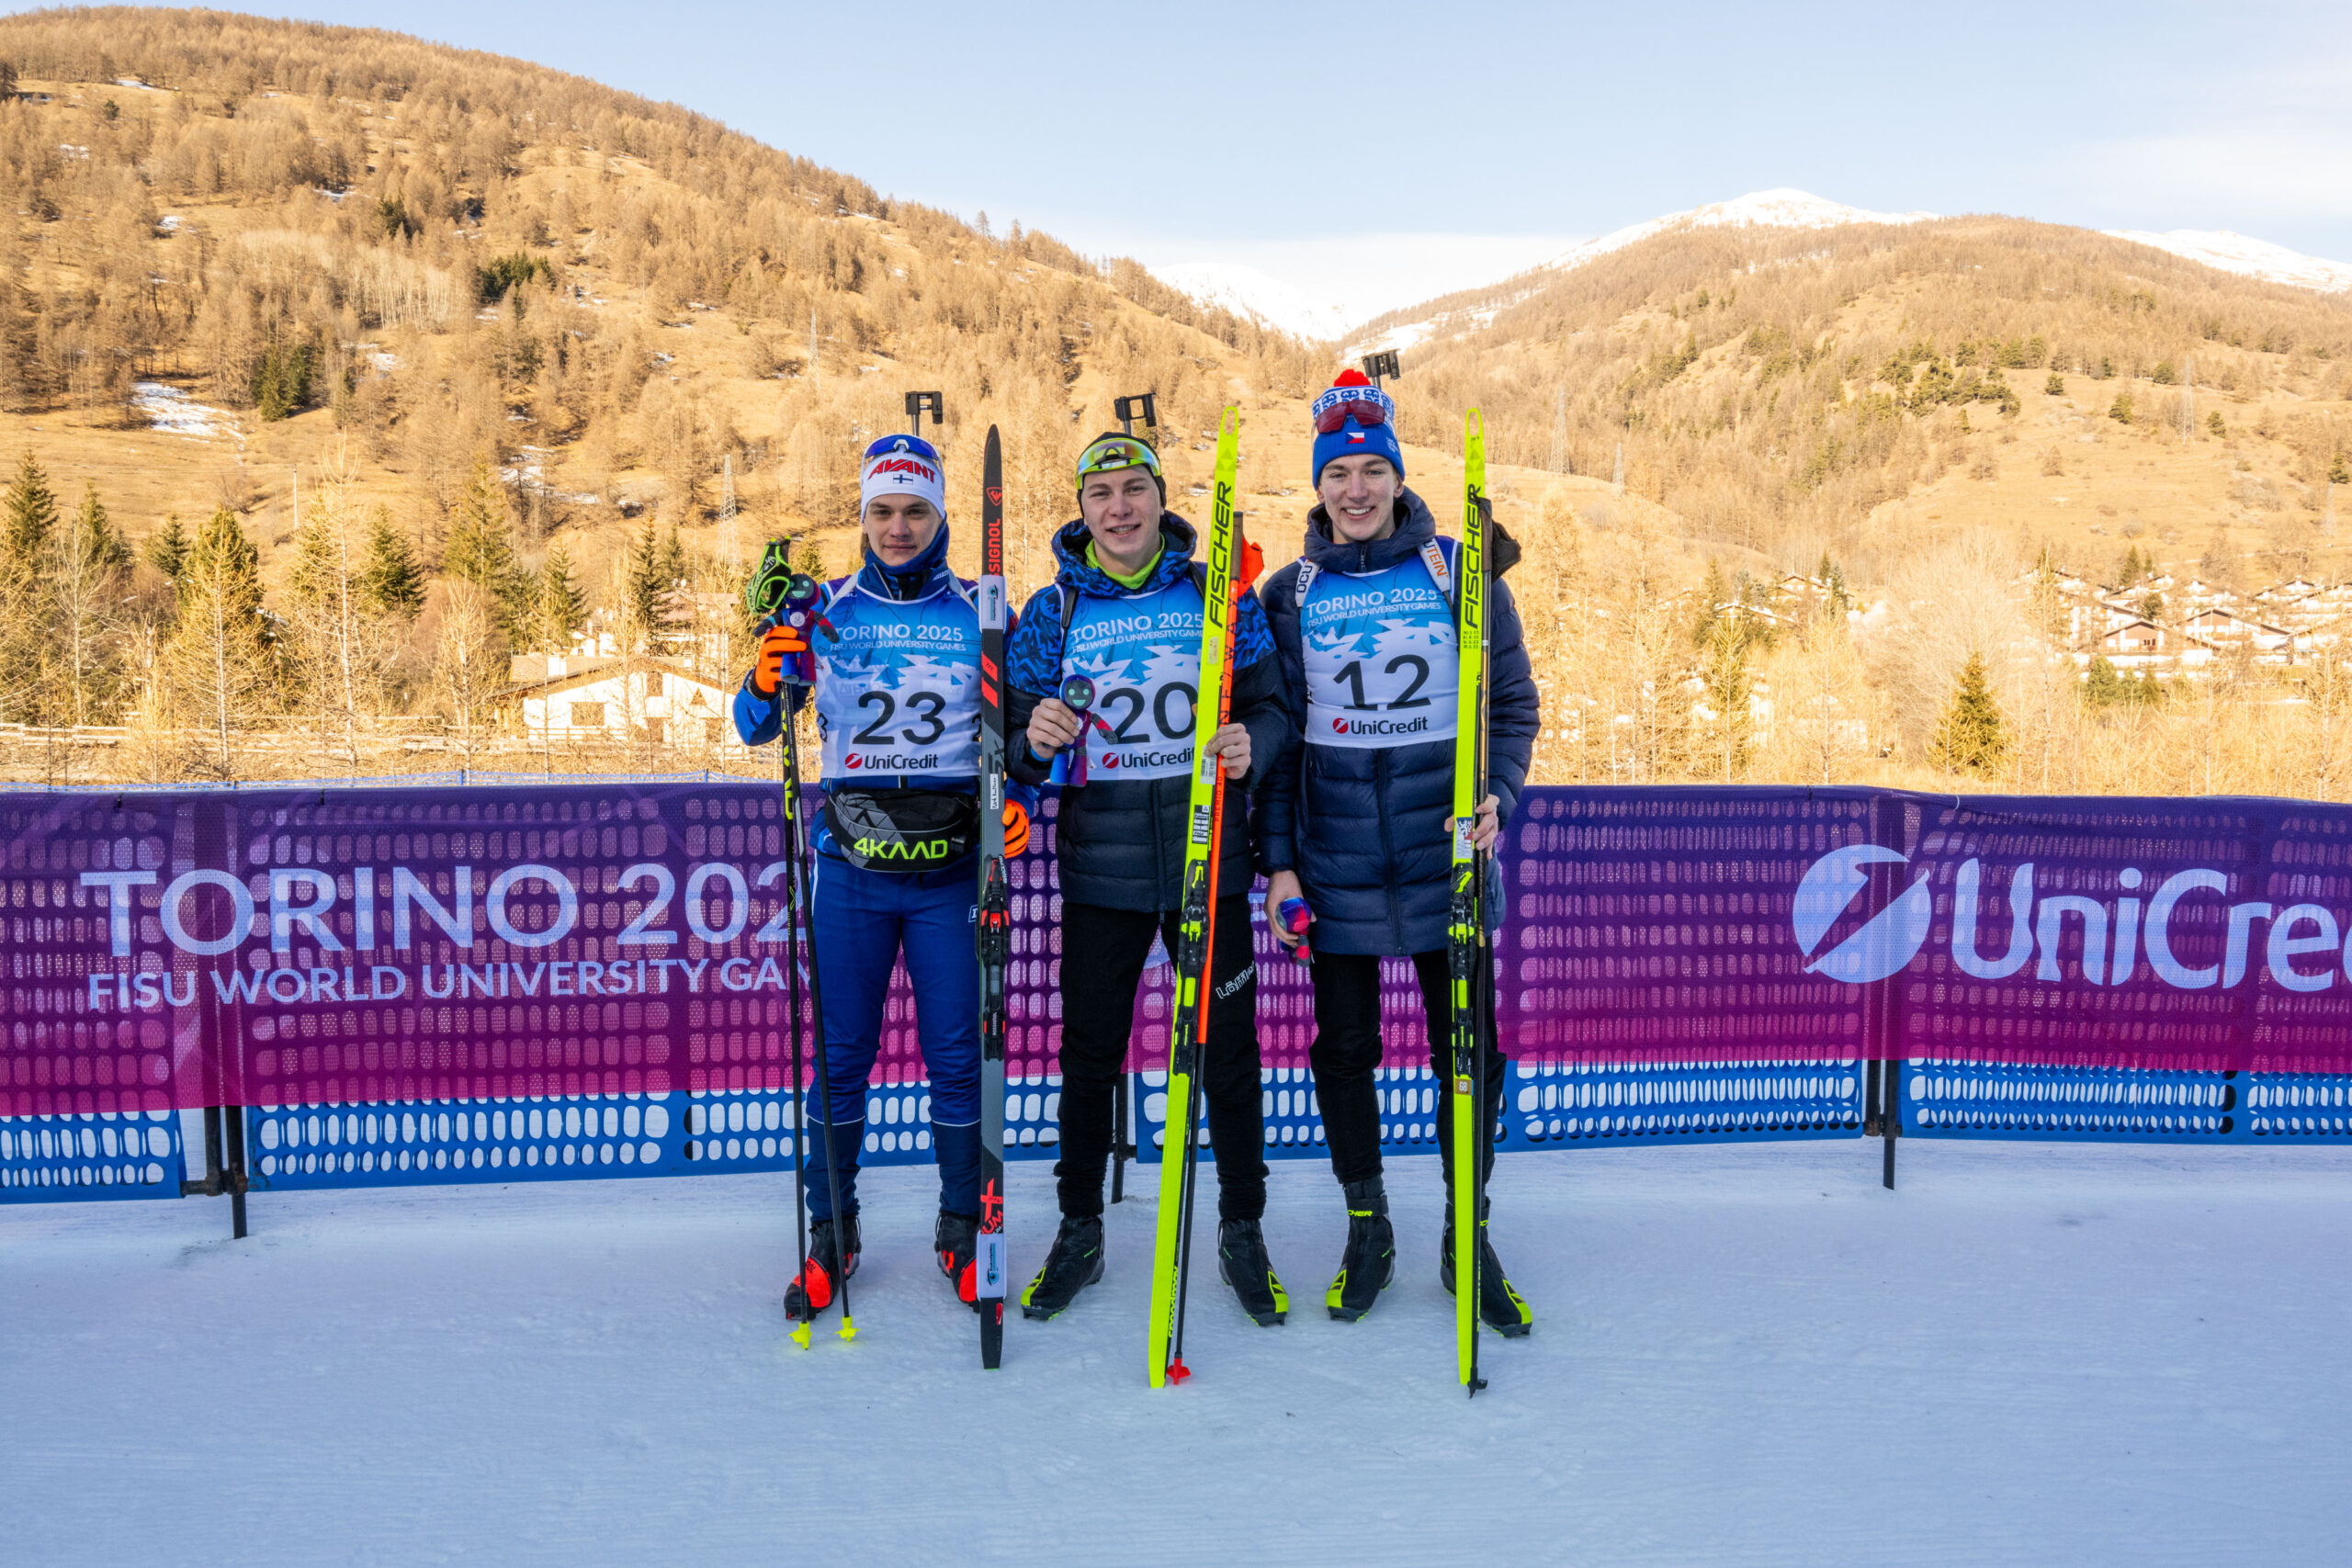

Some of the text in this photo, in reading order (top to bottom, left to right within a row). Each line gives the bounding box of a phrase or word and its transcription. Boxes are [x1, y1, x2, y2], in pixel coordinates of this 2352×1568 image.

[867, 458, 935, 483] AVANT
[989, 518, 1001, 576] SIGNOL
[1209, 480, 1232, 629] FISCHER
[1423, 539, 1448, 577] UTEIN
[1465, 483, 1482, 629] FISCHER
[1306, 587, 1438, 618] TORINO 2025
[1307, 602, 1442, 628] FISU WORLD UNIVERSITY GAMES
[916, 625, 964, 641] 2025
[1070, 612, 1204, 643] TORINO 2025
[1072, 642, 1090, 654] FISU
[1090, 636, 1125, 649] WORLD
[1125, 629, 1179, 642] UNIVERSITY
[830, 640, 967, 651] FISU WORLD UNIVERSITY GAMES
[1333, 654, 1431, 711] 12
[852, 690, 946, 745] 23
[1101, 681, 1198, 743] 20
[1351, 716, 1429, 735] UniCredit
[864, 753, 939, 770] UniCredit
[80, 863, 579, 957] TORINO
[616, 861, 807, 945] 202
[88, 970, 197, 1010] FISU
[209, 965, 407, 1006] WORLD
[422, 958, 710, 998] UNIVERSITY
